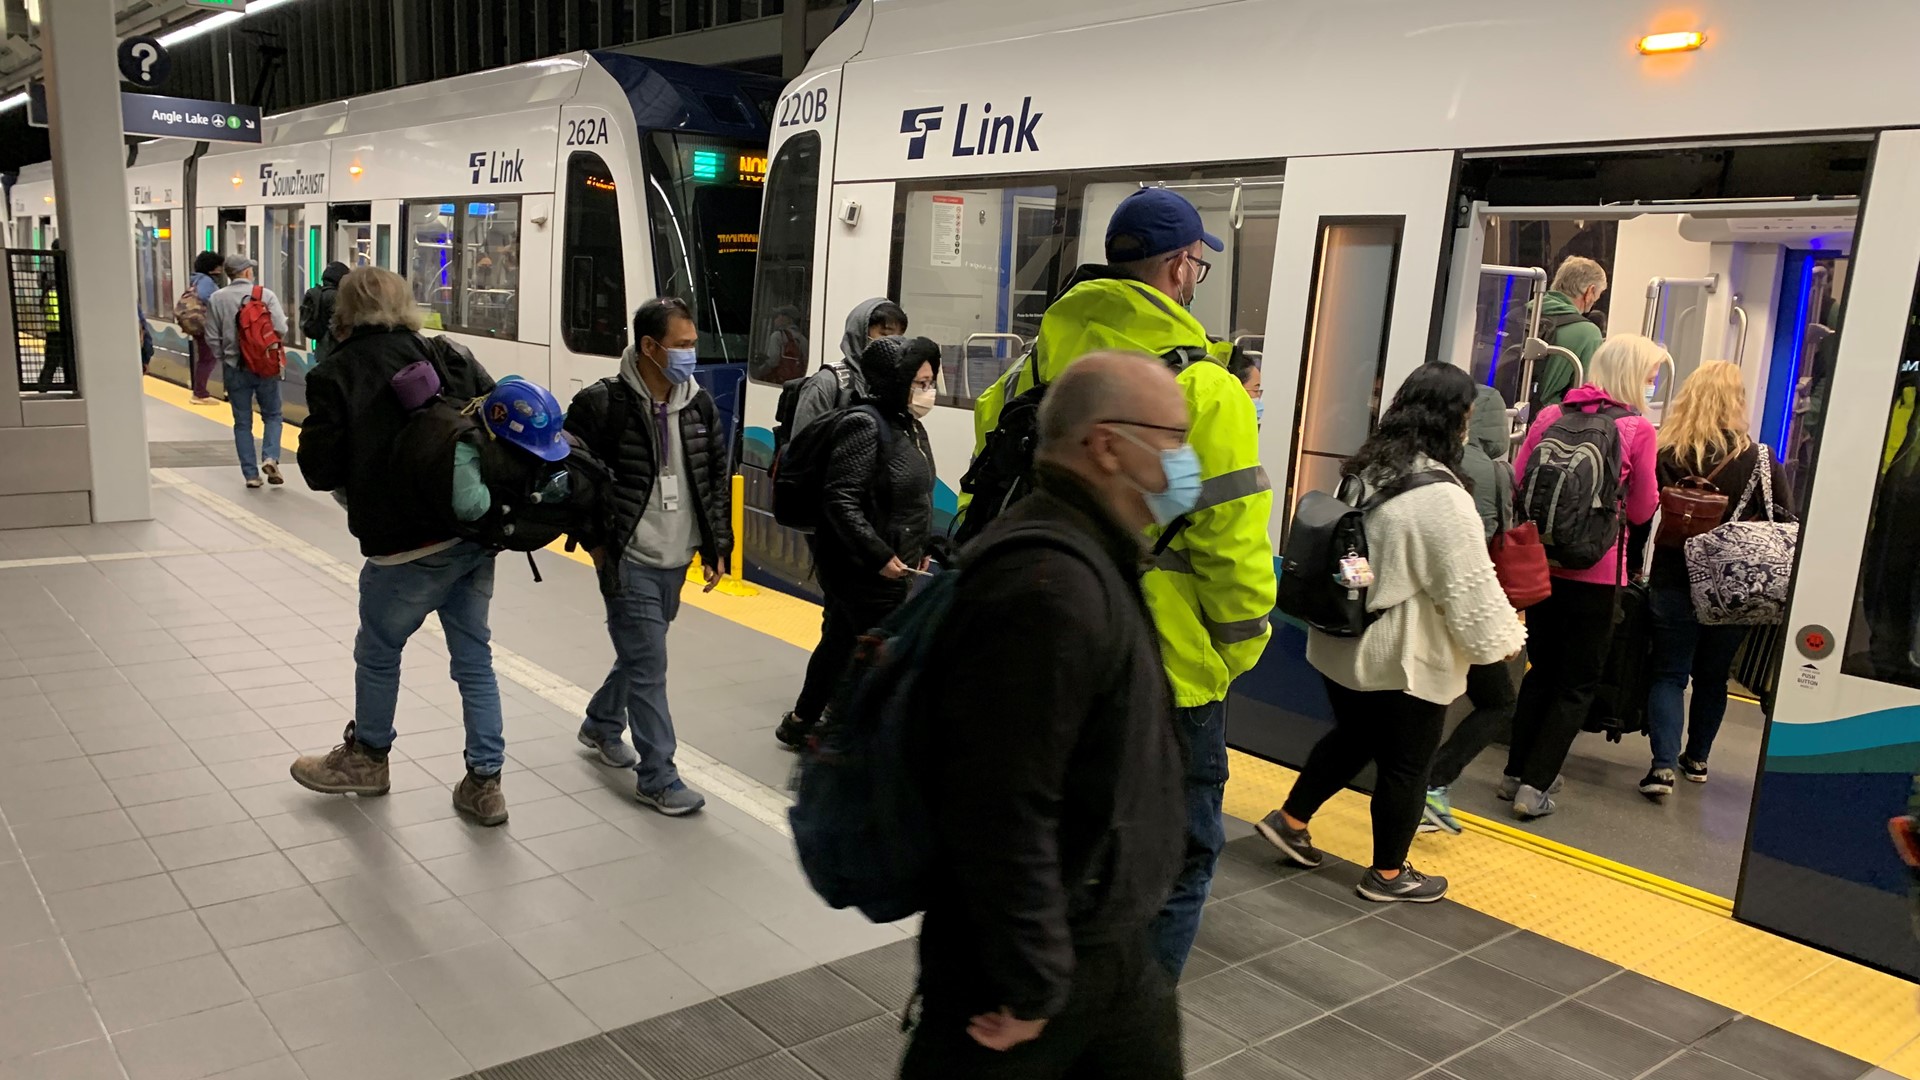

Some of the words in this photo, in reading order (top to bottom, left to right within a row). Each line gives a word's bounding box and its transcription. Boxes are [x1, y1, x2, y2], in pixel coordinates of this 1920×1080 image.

[151, 109, 183, 124] Angle
[185, 112, 209, 125] Lake
[779, 87, 828, 127] 220B
[566, 117, 609, 146] 262A
[951, 95, 1044, 157] Link
[489, 148, 524, 184] Link
[1797, 677, 1819, 686] BUTTON
[1801, 672, 1816, 680] PUSH
